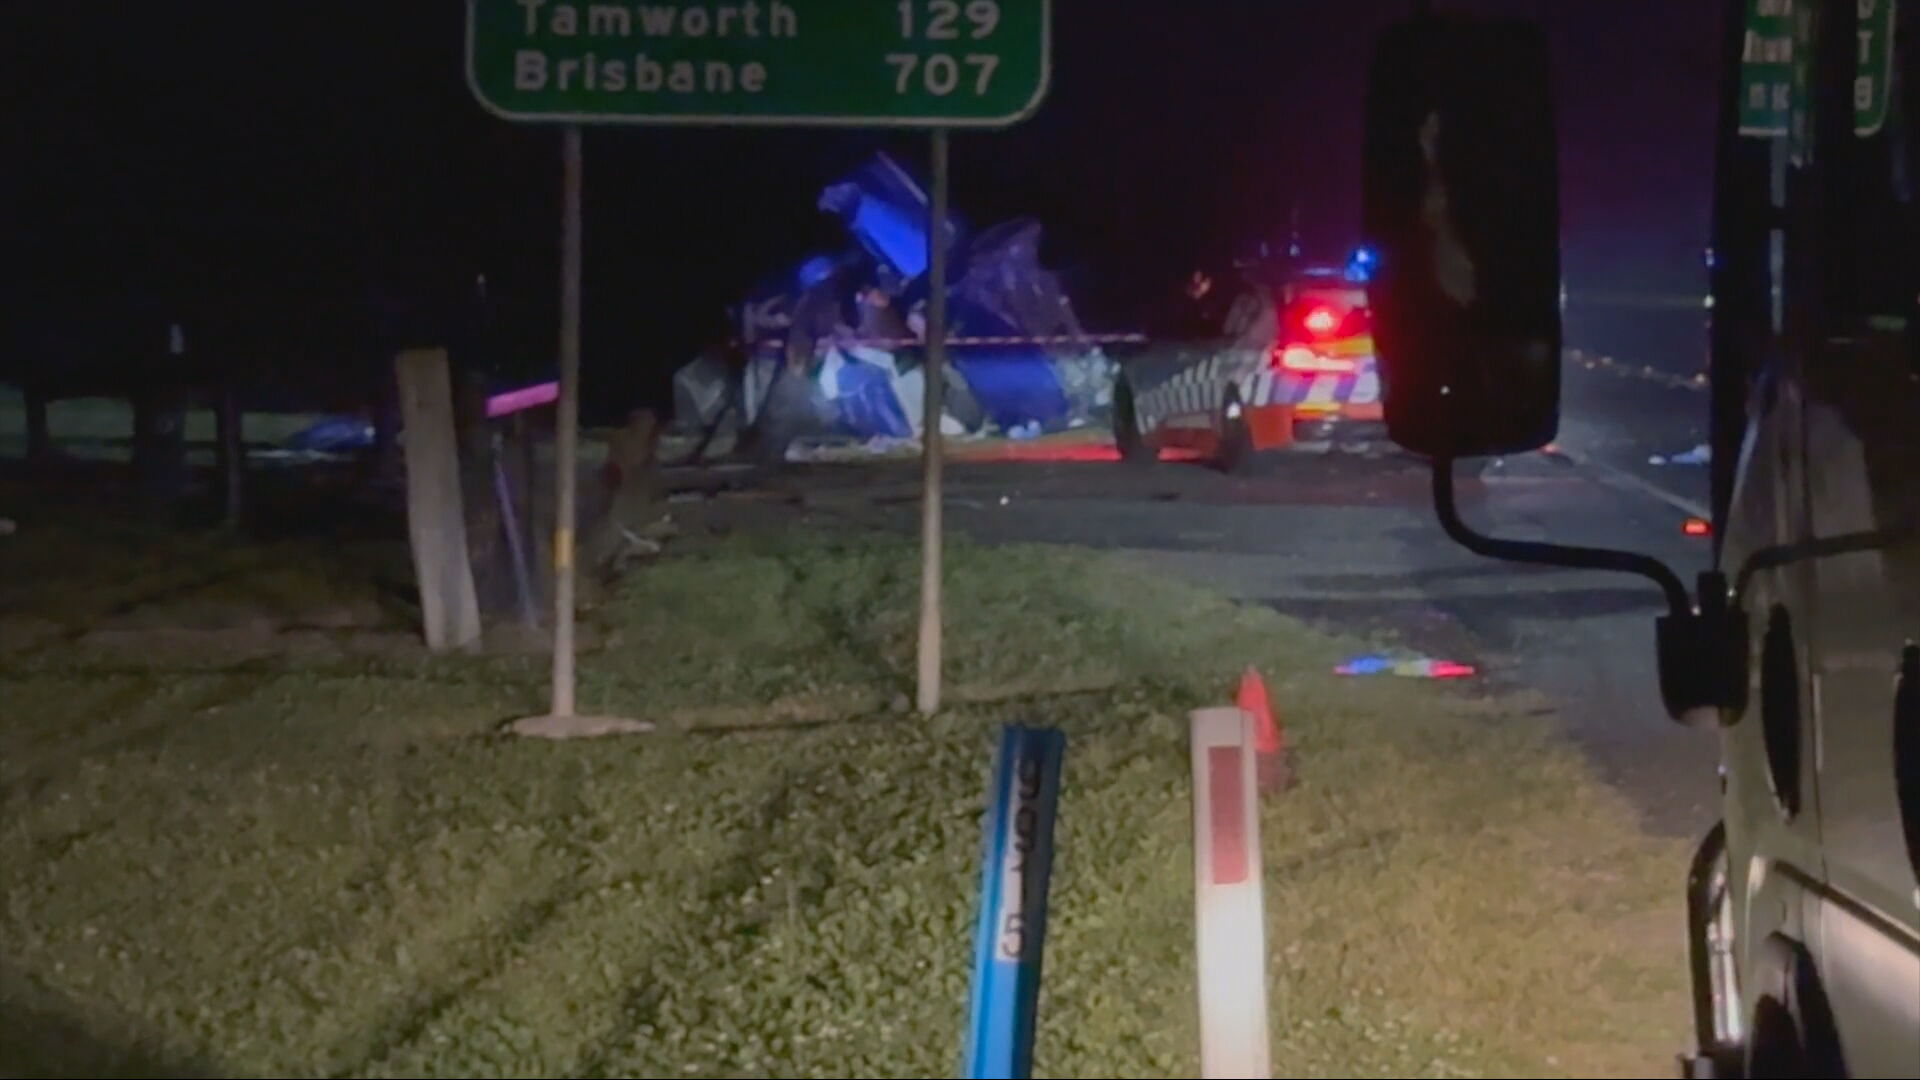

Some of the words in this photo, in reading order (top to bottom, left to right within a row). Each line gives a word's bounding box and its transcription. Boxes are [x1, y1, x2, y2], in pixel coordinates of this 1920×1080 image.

[518, 0, 798, 36] Tamworth
[897, 0, 999, 39] 129
[514, 50, 768, 92] Brisbane
[884, 53, 999, 95] 707
